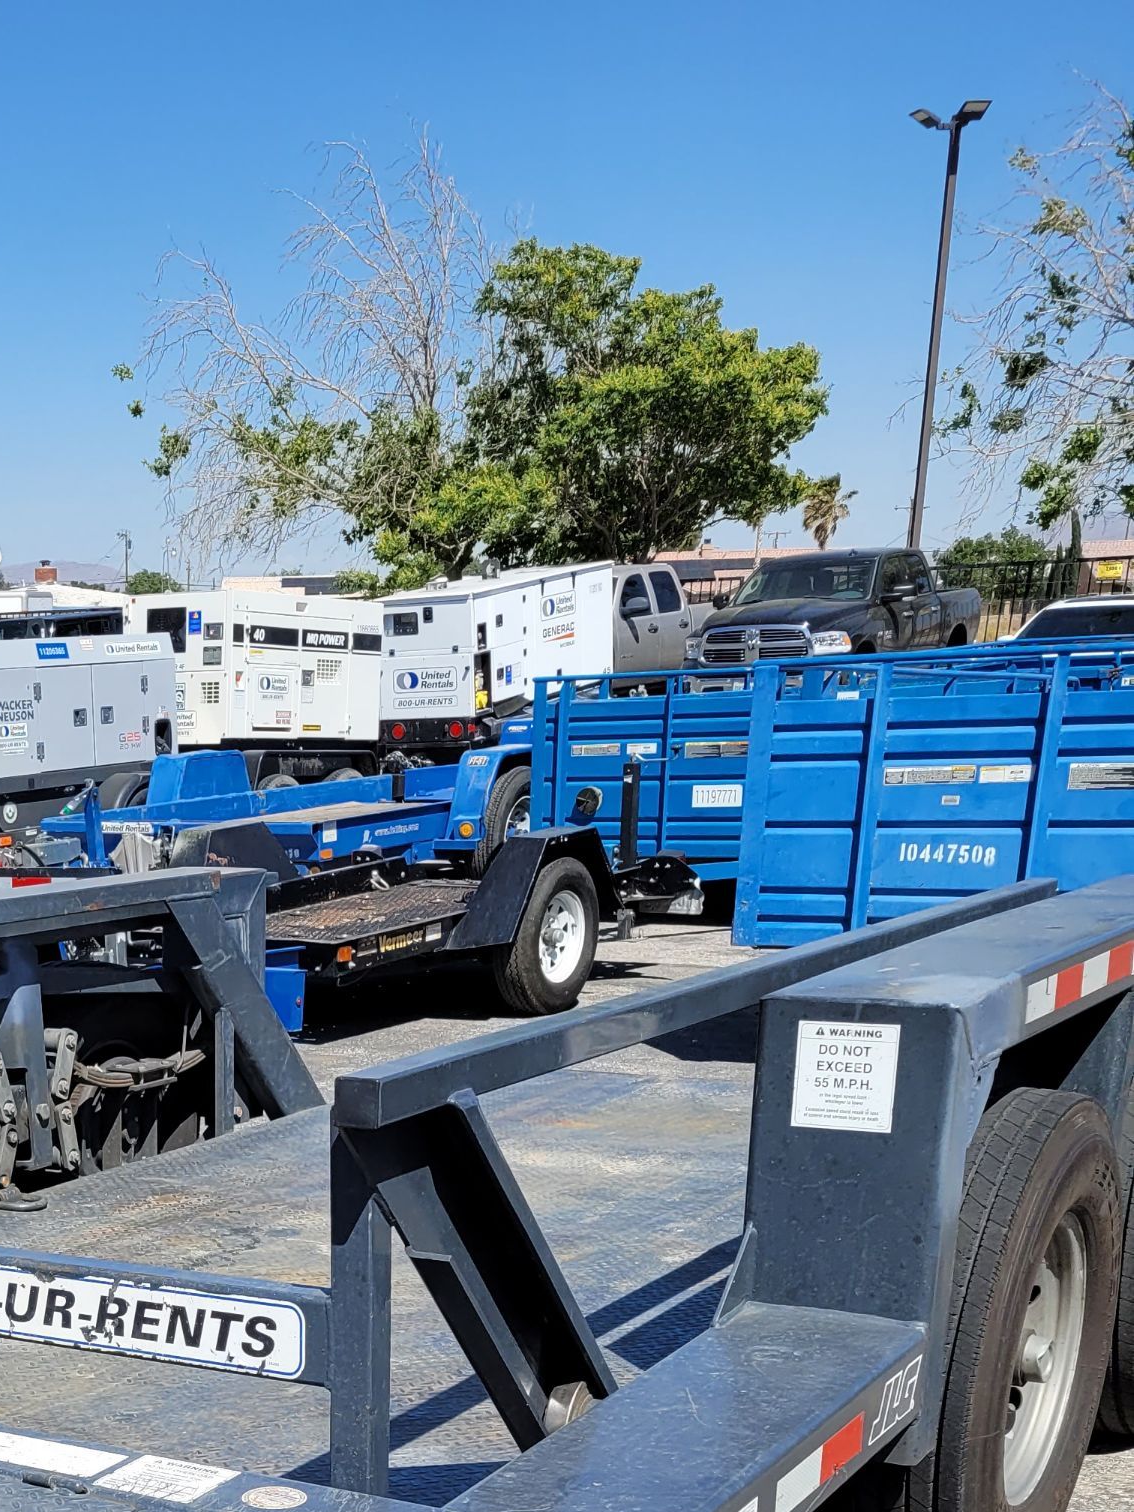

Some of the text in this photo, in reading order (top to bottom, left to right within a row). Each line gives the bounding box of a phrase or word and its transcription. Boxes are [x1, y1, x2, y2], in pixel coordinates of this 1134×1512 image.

[555, 594, 573, 606] United
[556, 603, 575, 615] Rentals
[253, 628, 265, 642] 40
[542, 622, 575, 638] GENERAC
[306, 633, 345, 647] MQ POWER
[115, 643, 159, 653] United Rentals
[421, 670, 451, 680] United
[420, 679, 454, 689] Rentals
[397, 698, 453, 707] 800-UR-RENTS
[118, 731, 142, 743] G25
[695, 788, 738, 804] 11197771
[102, 824, 150, 833] United Rentals
[899, 842, 997, 867] 10447508
[378, 929, 425, 954] Vermeer
[818, 1044, 872, 1057] DO NOT
[816, 1060, 873, 1074] EXCEED
[814, 1077, 874, 1091] 55 M.P.H.
[868, 1355, 923, 1447] JLG
